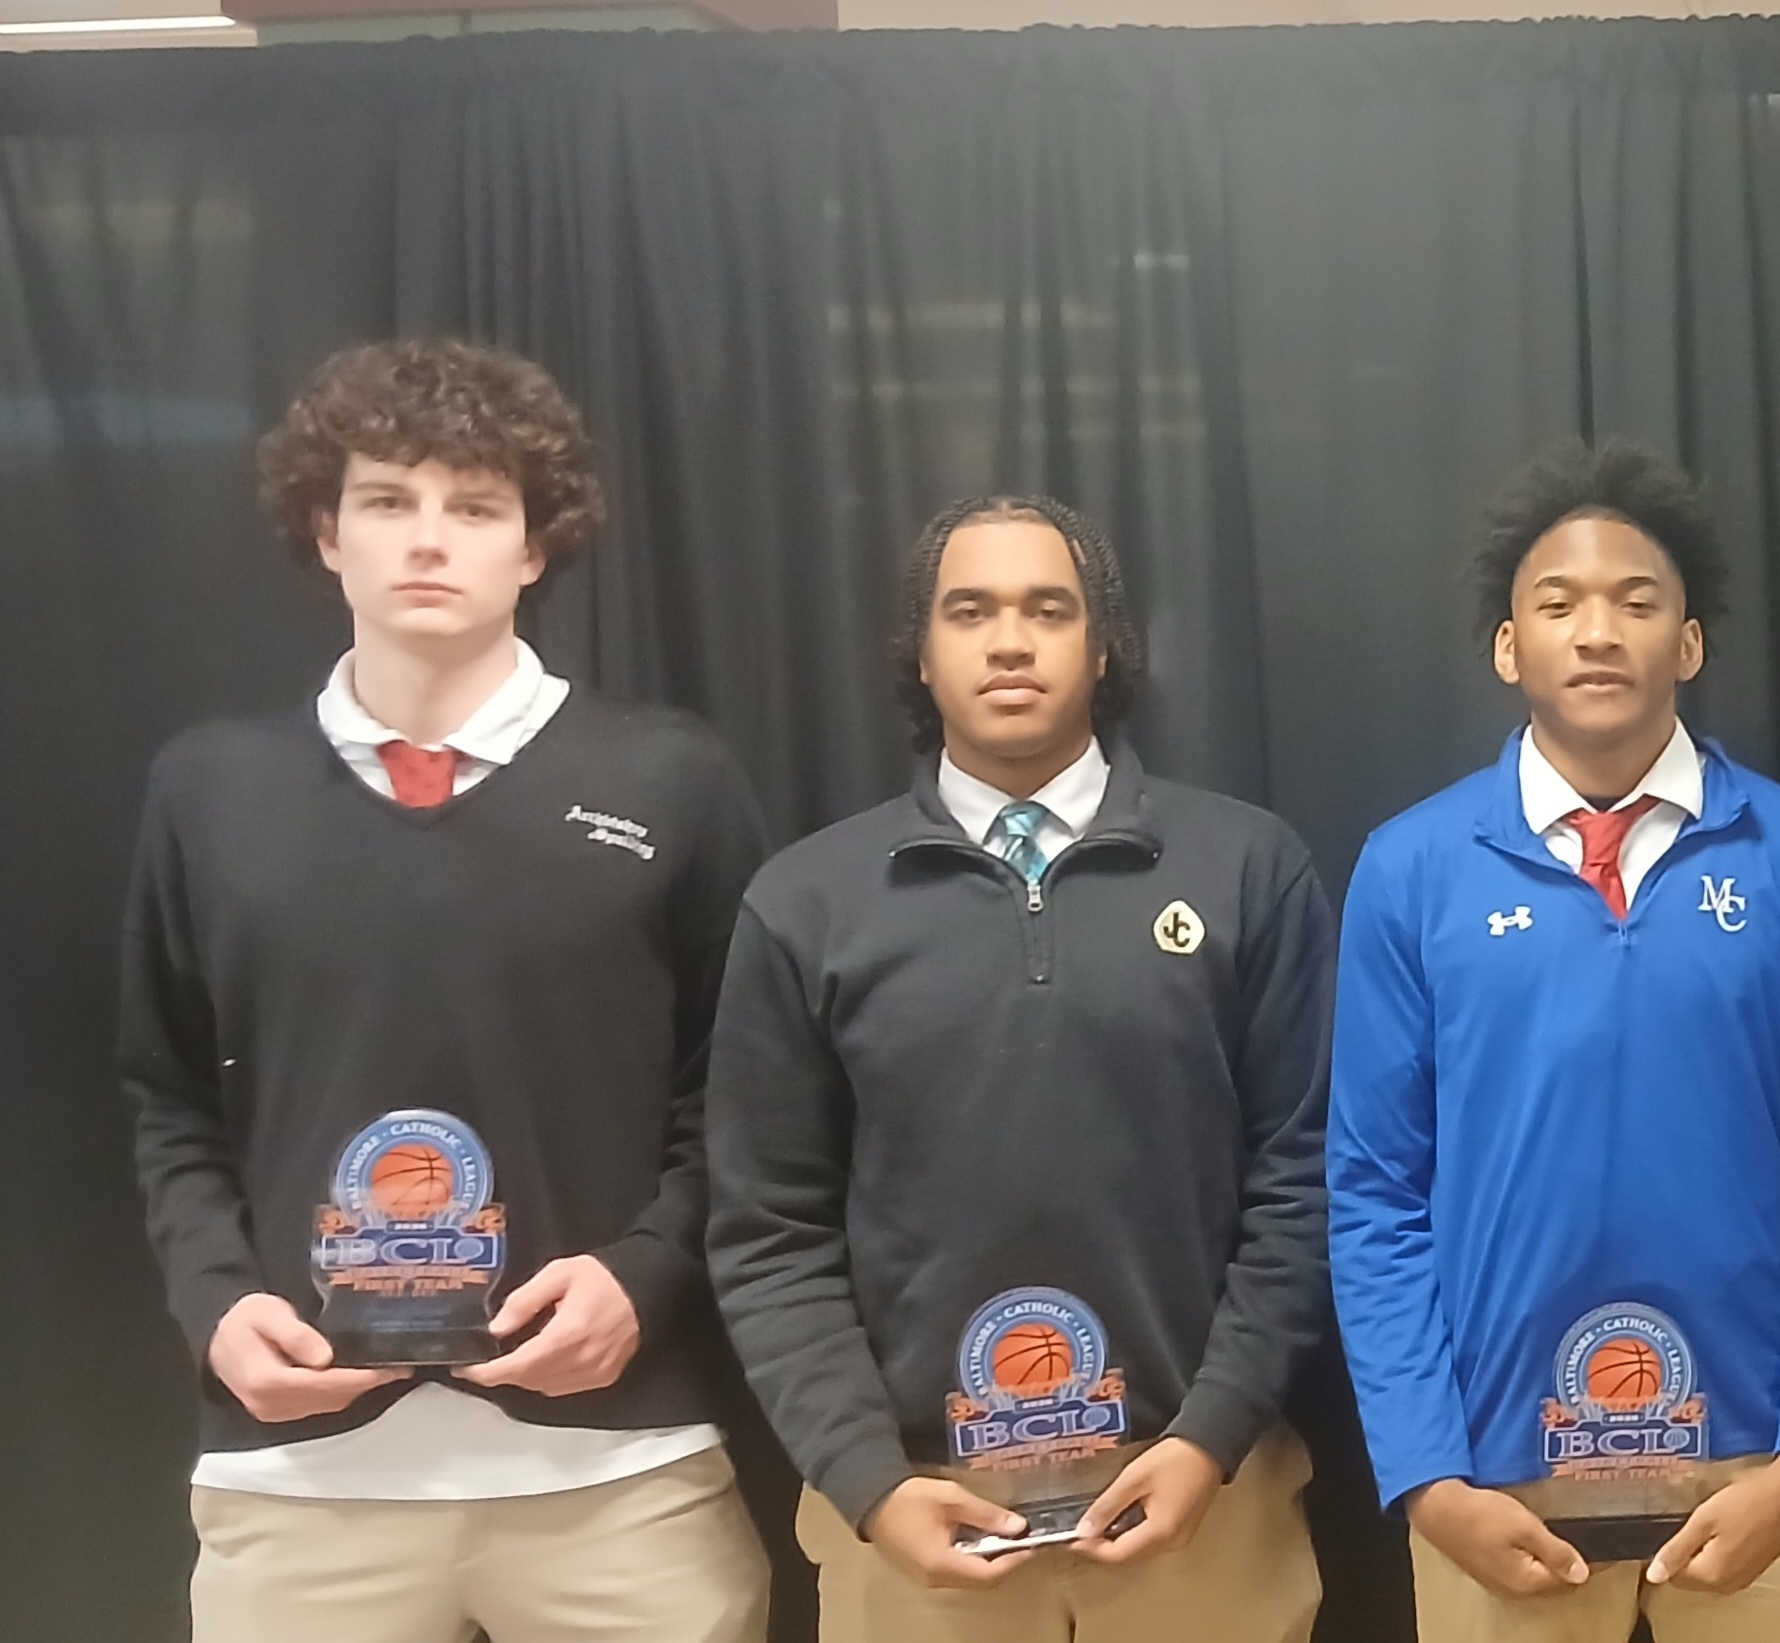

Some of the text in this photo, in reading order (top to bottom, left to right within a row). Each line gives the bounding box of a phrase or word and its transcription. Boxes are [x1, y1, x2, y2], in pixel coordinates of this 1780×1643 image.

[1698, 875, 1747, 931] MC
[1163, 912, 1190, 947] JC
[390, 1121, 462, 1149] CATHOLIC
[335, 1238, 470, 1265] BCL
[1004, 1301, 1074, 1324] CATHOLIC
[1603, 1317, 1669, 1343] CATHOLIC
[968, 1409, 1104, 1450] BCL
[1556, 1428, 1677, 1458] BCL
